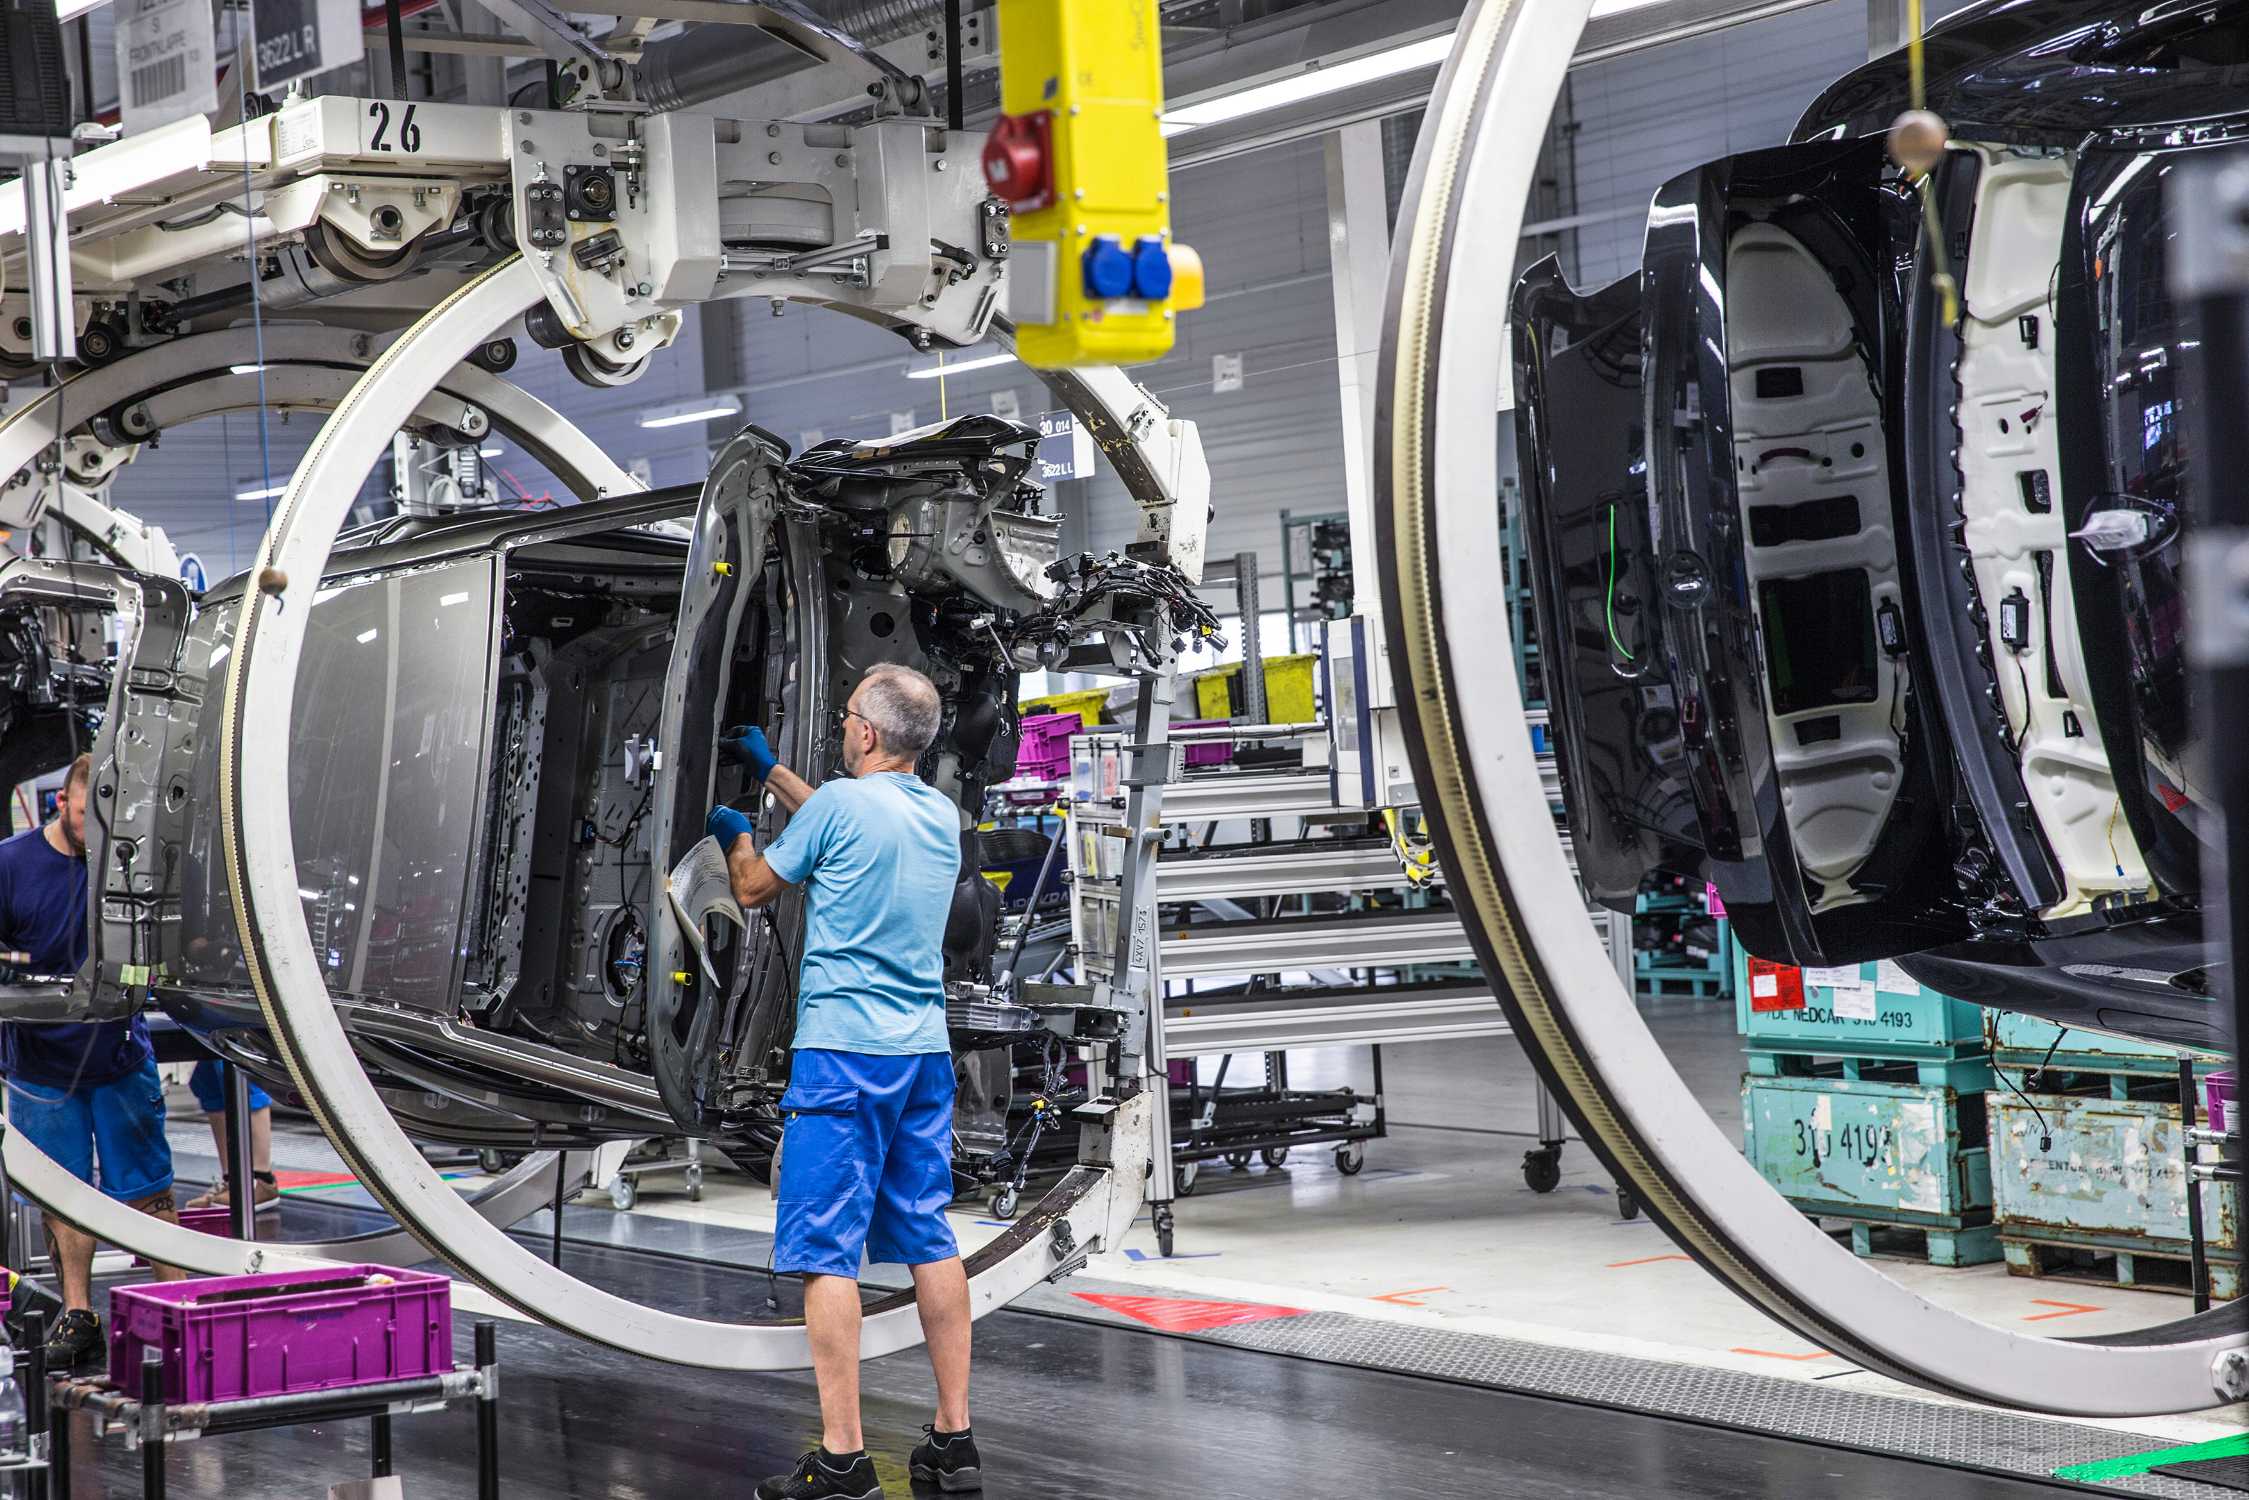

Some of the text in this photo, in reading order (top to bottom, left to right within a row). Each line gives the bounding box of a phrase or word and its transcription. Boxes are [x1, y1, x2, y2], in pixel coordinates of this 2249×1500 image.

[370, 102, 420, 153] 26
[1040, 420, 1070, 435] 30 014
[1880, 1011, 1912, 1028] 4193
